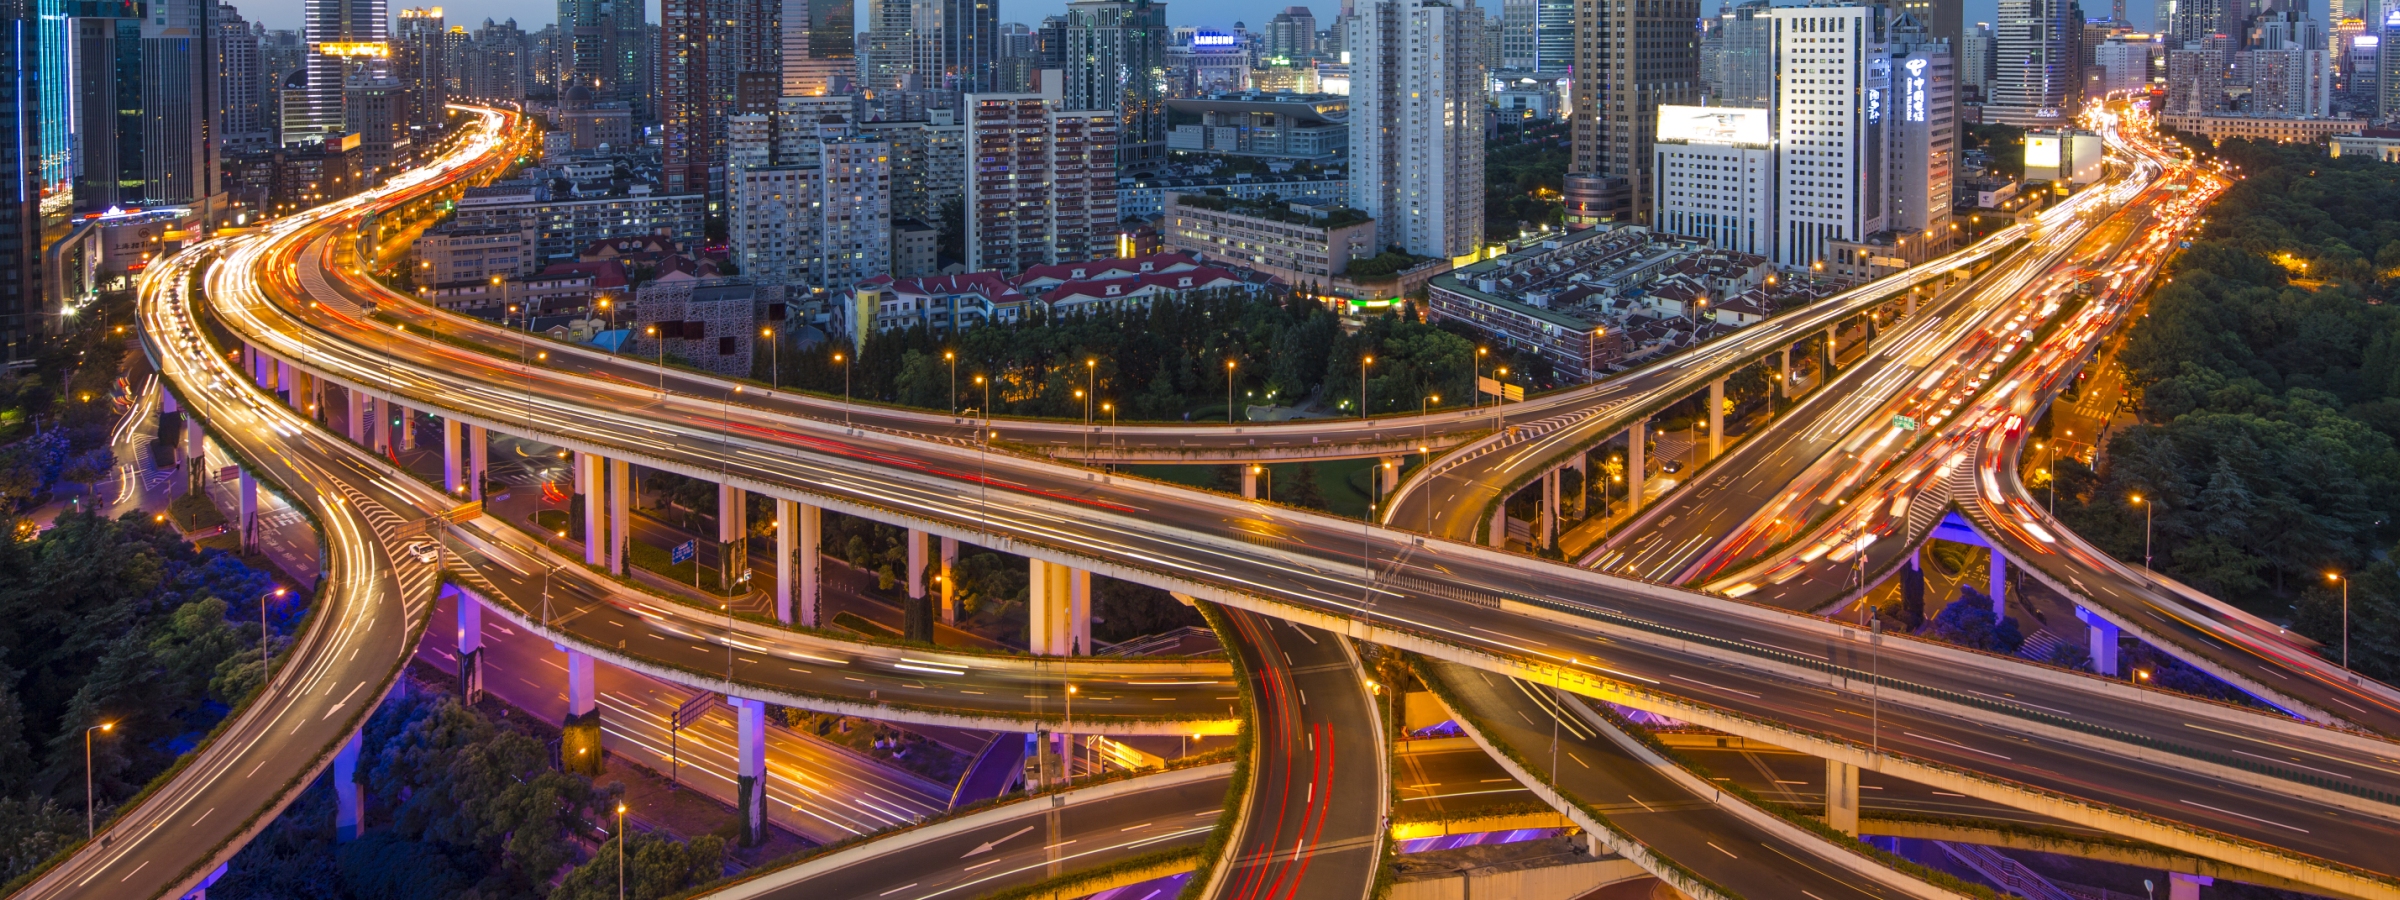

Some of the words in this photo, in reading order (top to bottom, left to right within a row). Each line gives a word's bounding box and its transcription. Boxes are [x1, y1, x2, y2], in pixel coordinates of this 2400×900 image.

[1194, 35, 1234, 45] SAMSUNG
[1913, 77, 1925, 122] 中国电信
